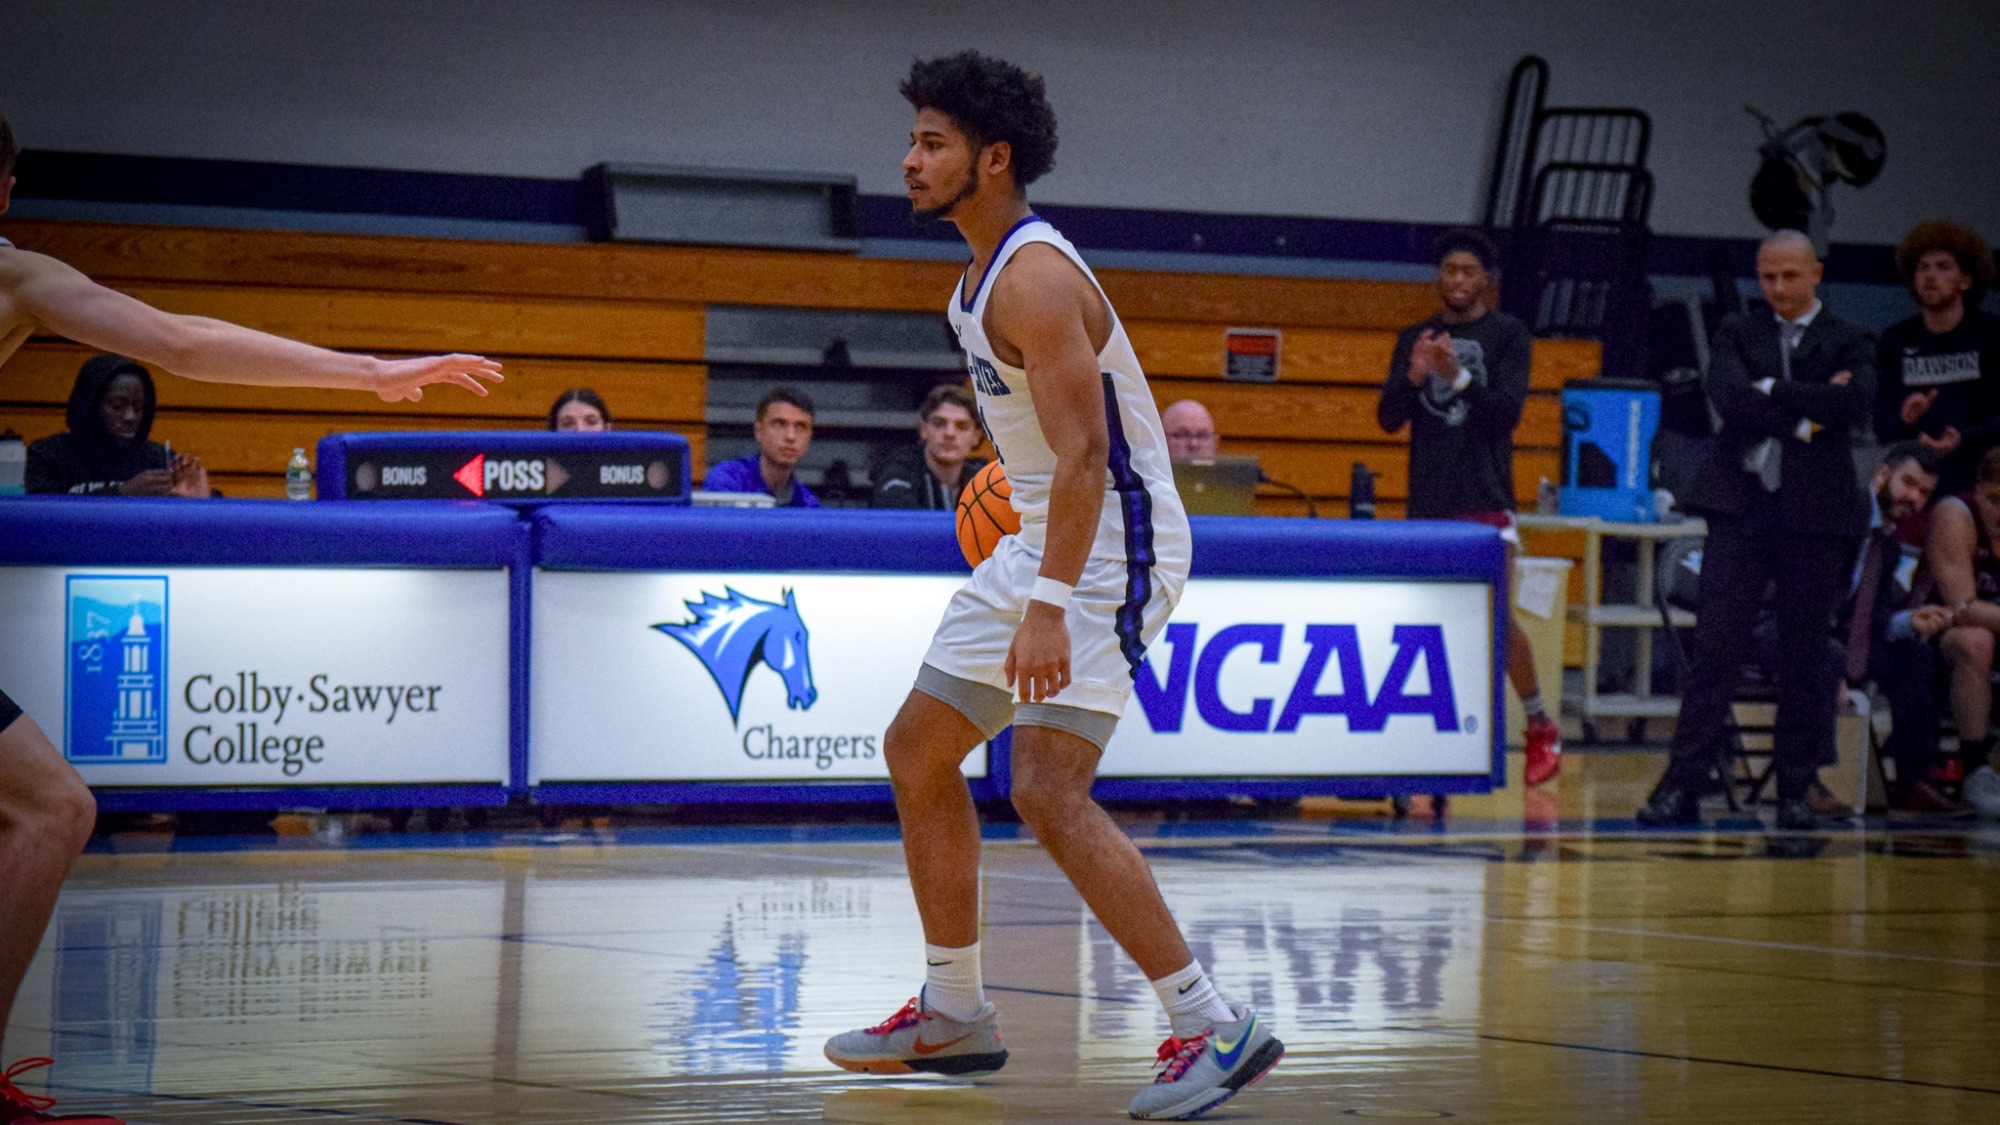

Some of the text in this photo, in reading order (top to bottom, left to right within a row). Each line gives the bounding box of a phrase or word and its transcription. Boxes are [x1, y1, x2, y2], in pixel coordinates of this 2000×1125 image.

[1902, 352, 1979, 377] DAWSON
[382, 460, 644, 491] BONUS POSS BONUS
[77, 610, 112, 673] 1837
[1134, 622, 1460, 734] NCAA
[183, 722, 324, 776] College
[743, 724, 876, 770] Chargers
